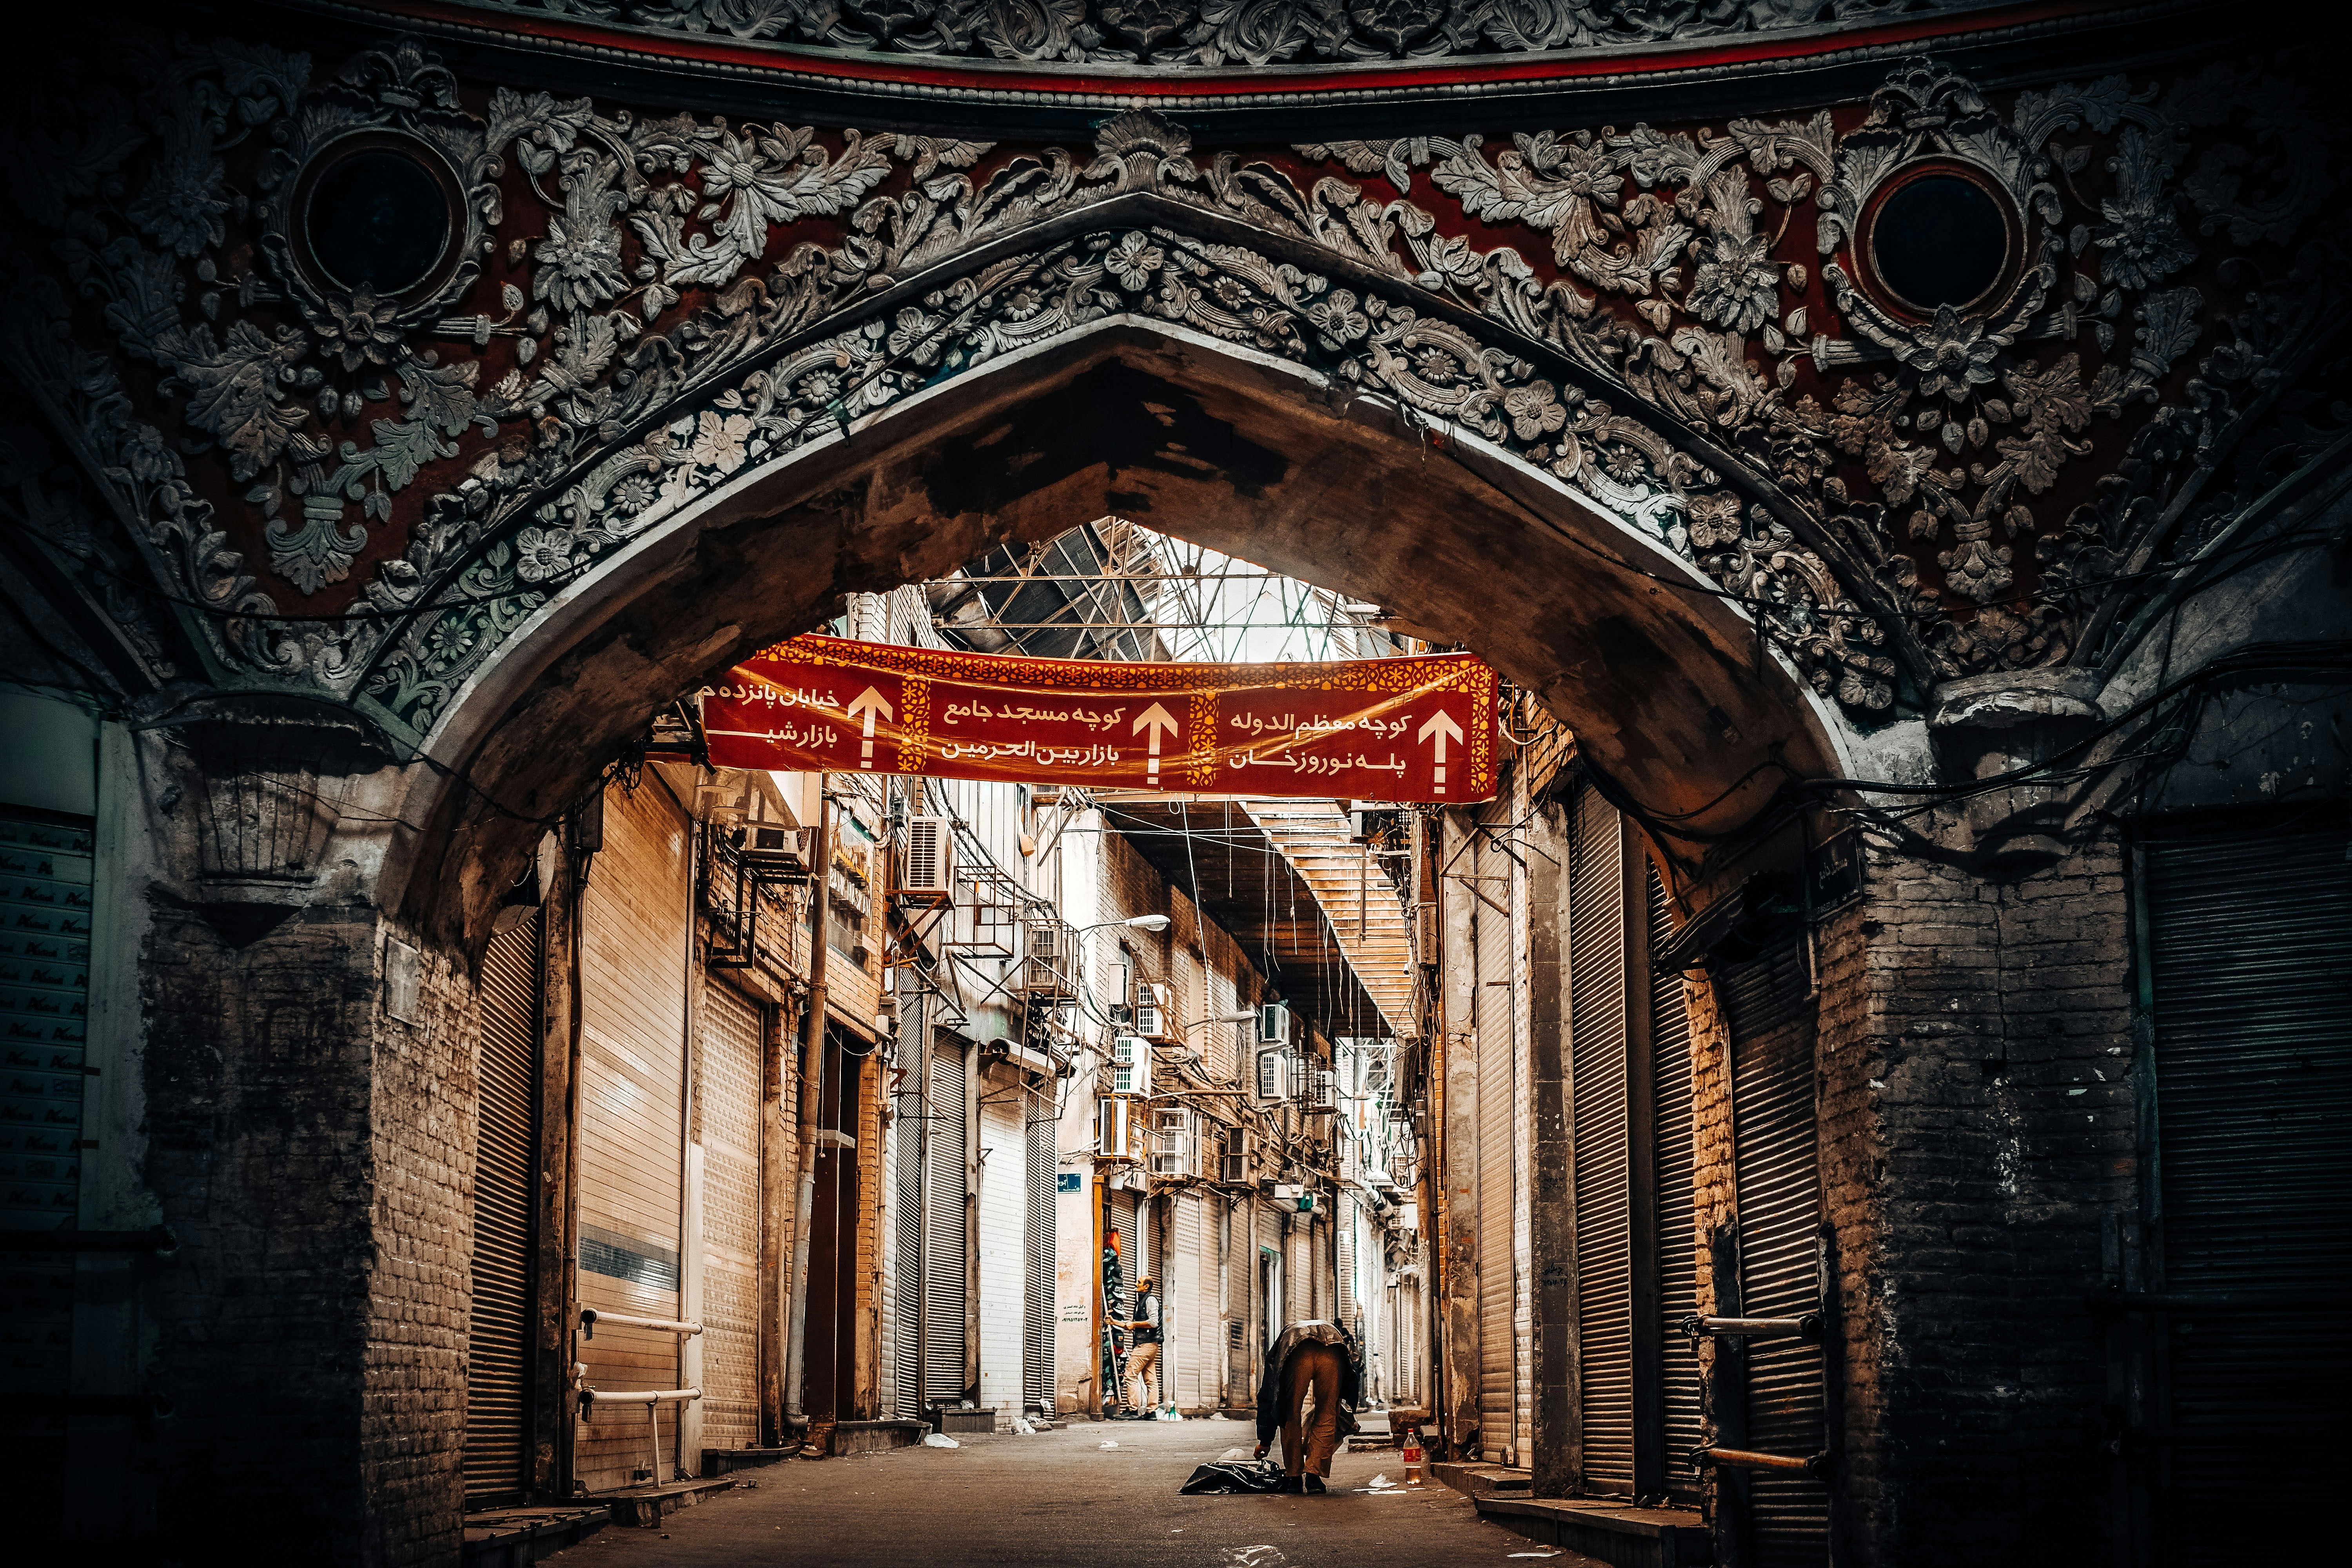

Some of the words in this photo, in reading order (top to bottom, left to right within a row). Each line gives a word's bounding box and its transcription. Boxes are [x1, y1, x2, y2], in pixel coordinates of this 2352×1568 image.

[719, 684, 777, 709] پانزده
[779, 688, 840, 711] خیابان
[943, 700, 993, 725] جامع
[996, 704, 1069, 724] مسجد
[1072, 707, 1126, 731] کوچه
[1230, 712, 1295, 736] الدوله
[796, 724, 837, 748] بازار
[1294, 714, 1360, 740] معظم
[1359, 715, 1413, 739] کوچه
[1079, 744, 1120, 767] بازار
[1355, 753, 1406, 779] پله
